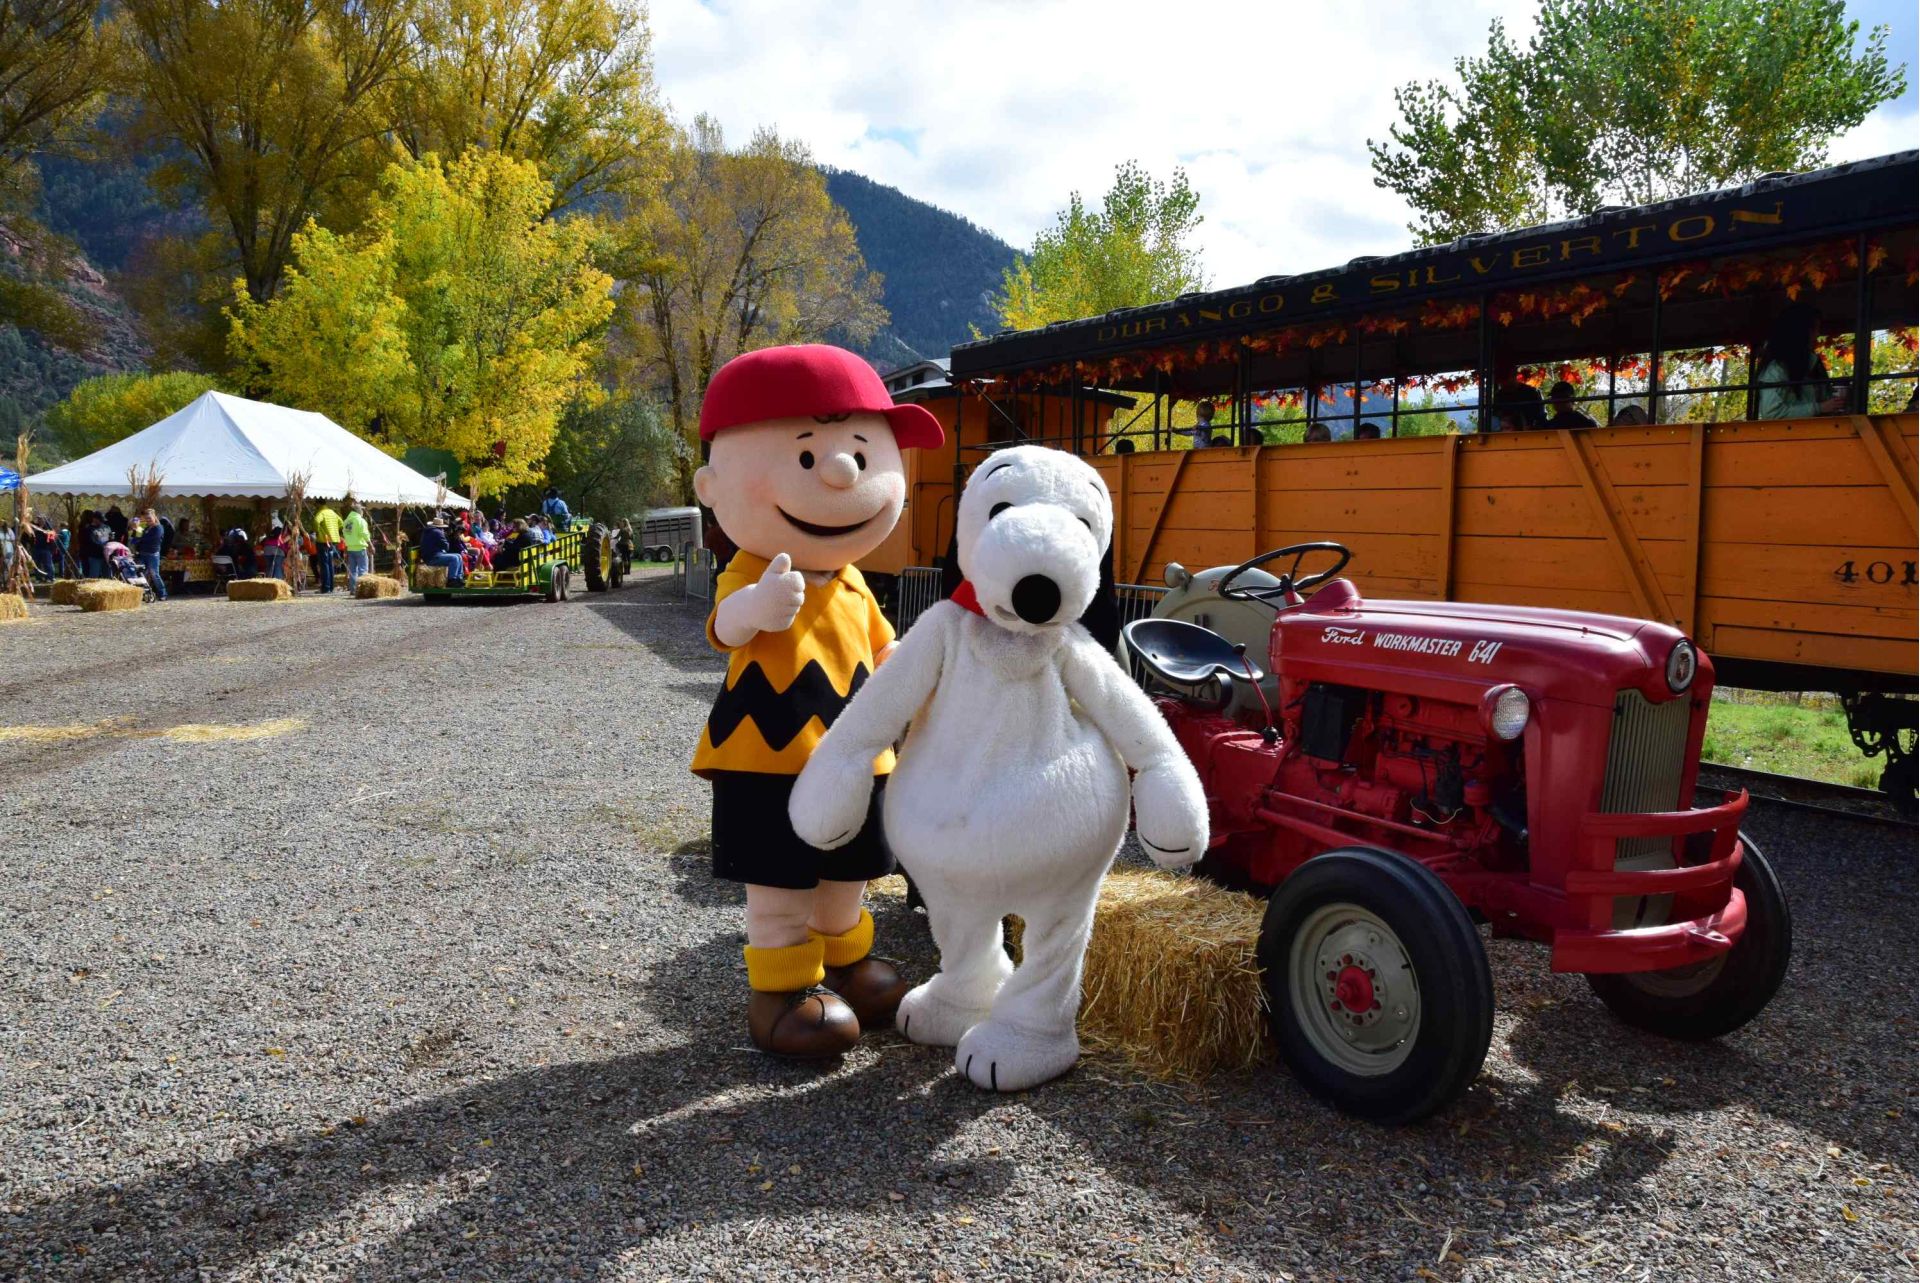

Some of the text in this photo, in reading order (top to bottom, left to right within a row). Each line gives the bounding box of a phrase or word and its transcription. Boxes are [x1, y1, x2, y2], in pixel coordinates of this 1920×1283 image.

[1098, 202, 1785, 342] DURANGO & SILVERTON
[1834, 561, 1919, 585] 401
[1321, 626, 1504, 664] Ford WORKMASTER 641
